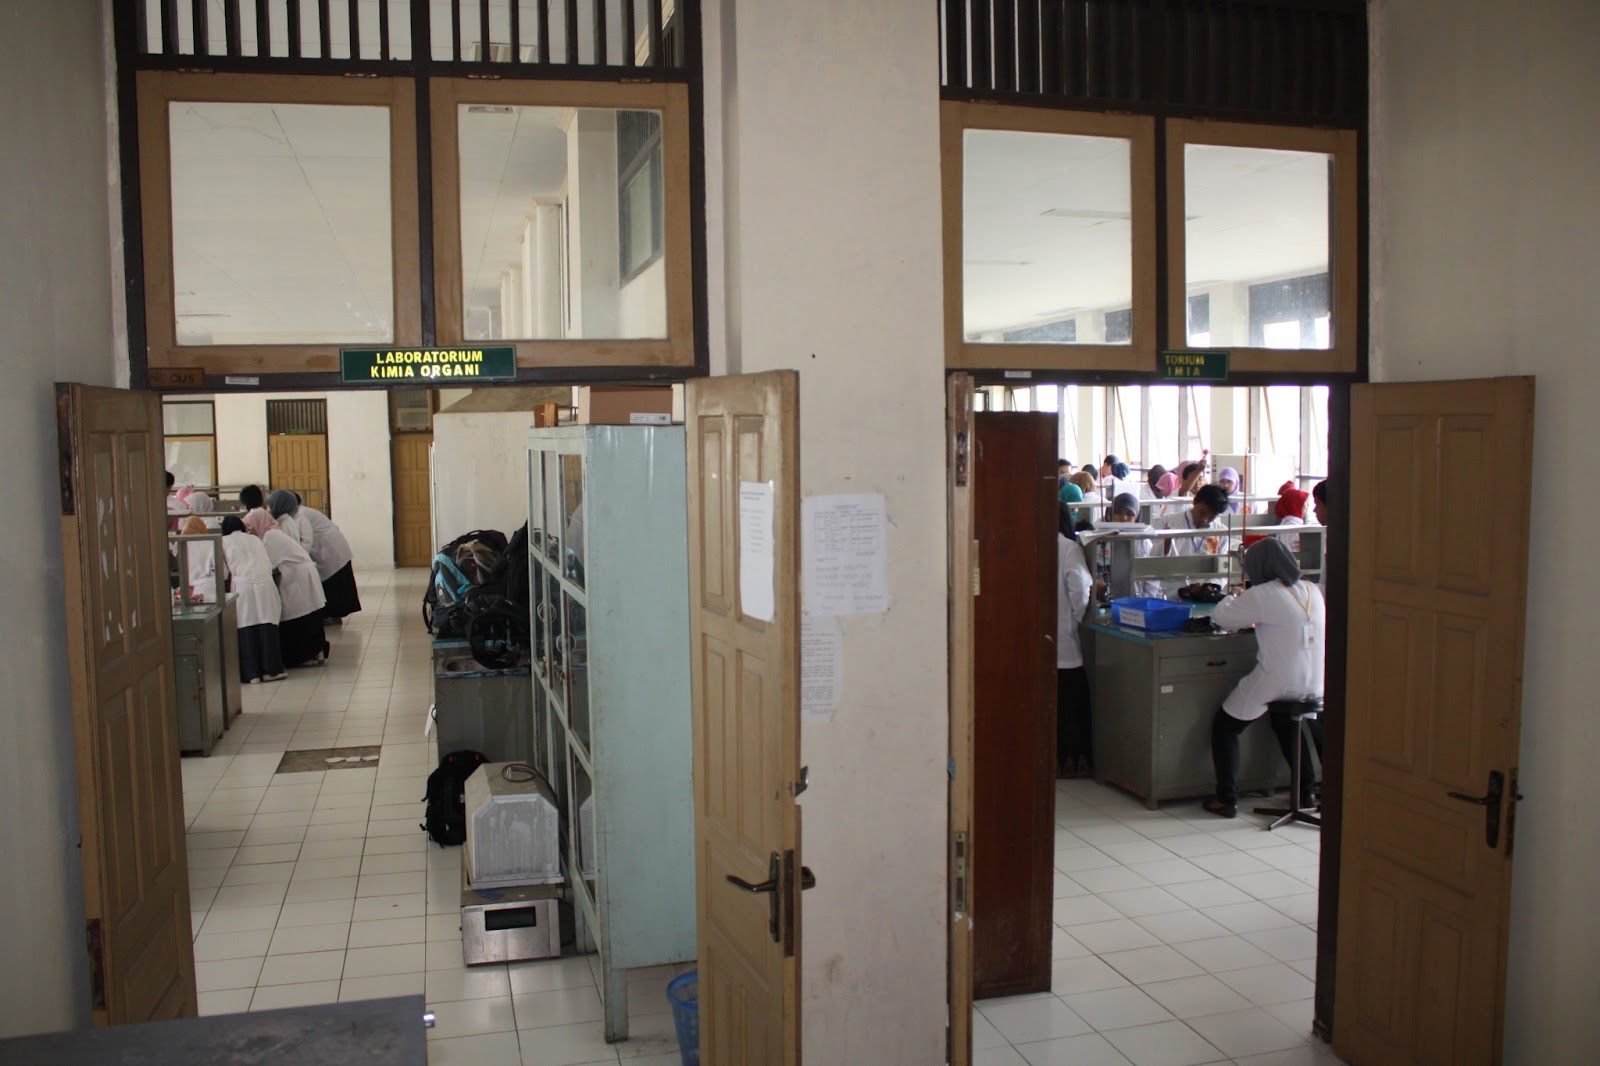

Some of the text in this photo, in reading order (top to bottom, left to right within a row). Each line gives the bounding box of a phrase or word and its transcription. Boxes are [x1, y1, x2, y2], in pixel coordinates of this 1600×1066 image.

[376, 350, 483, 364] LABORATORIUM
[1164, 354, 1205, 366] TORIUM
[370, 363, 479, 378] KIMIA ORGANI
